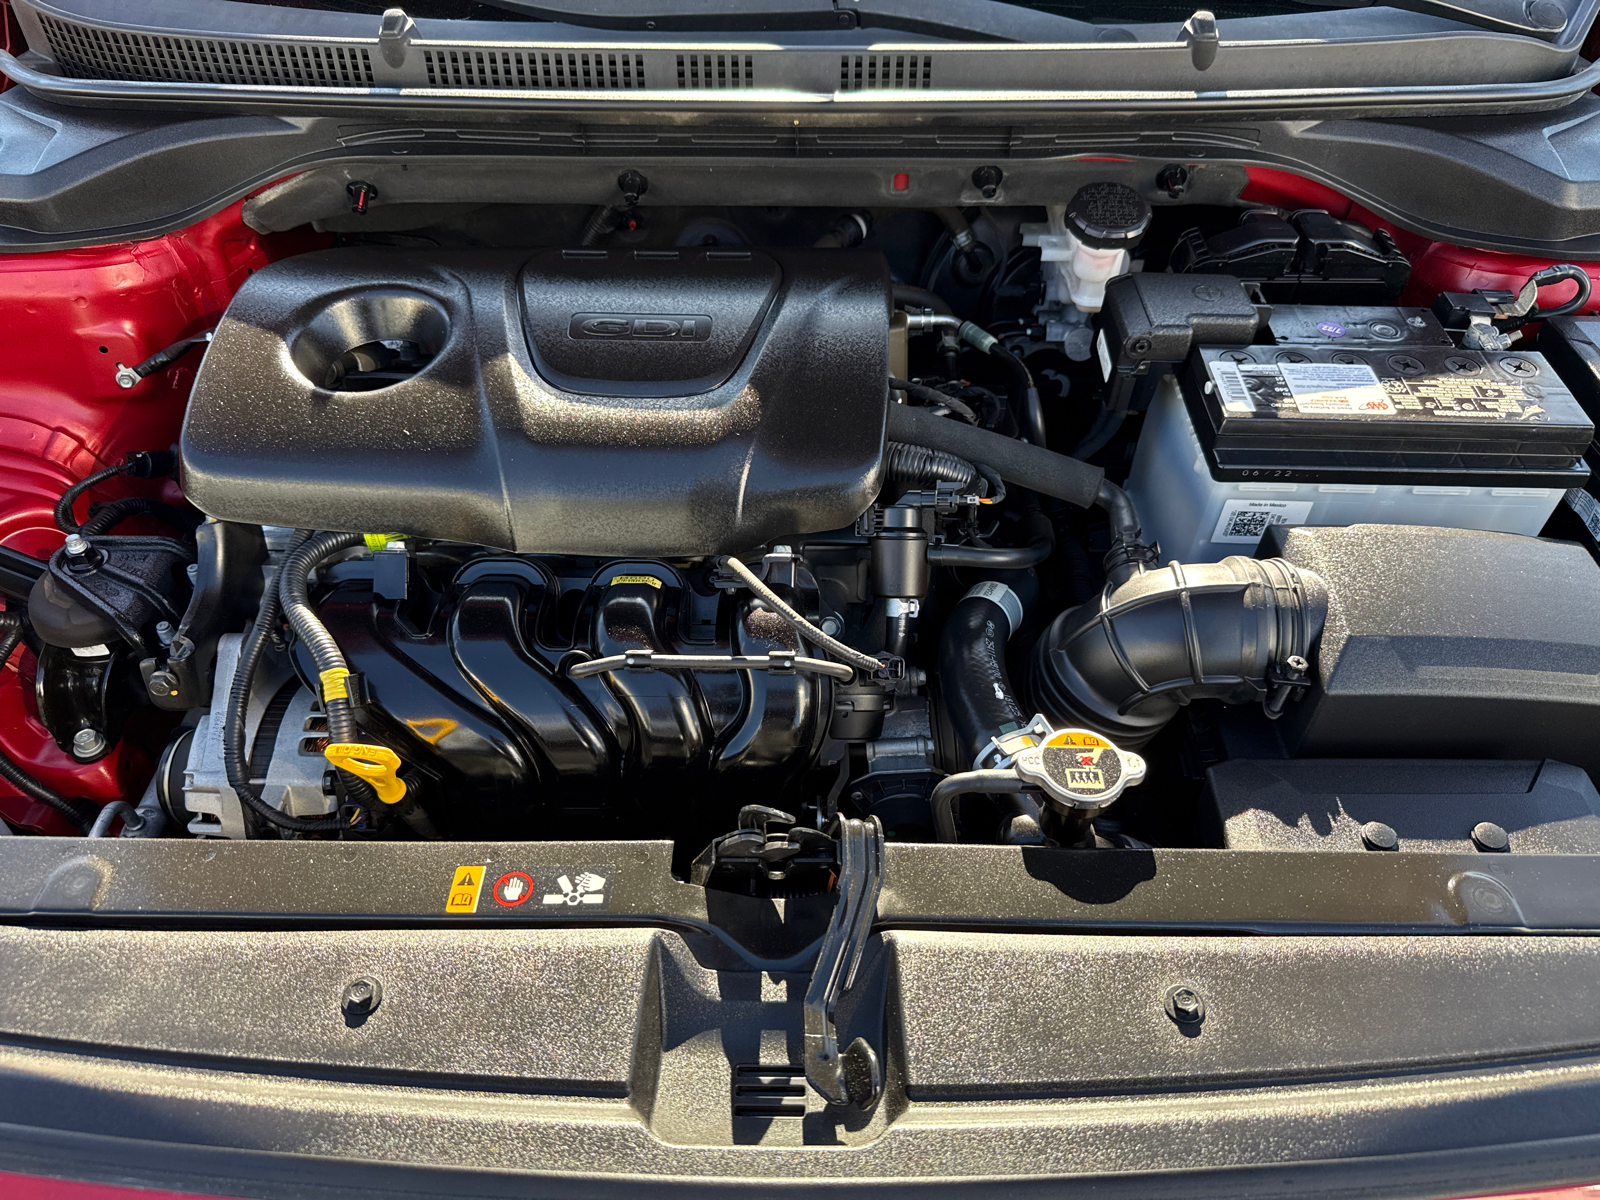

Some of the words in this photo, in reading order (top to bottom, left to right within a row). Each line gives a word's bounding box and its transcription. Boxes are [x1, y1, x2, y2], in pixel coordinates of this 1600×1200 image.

[581, 318, 696, 338] GDI
[1321, 324, 1342, 335] 7/22
[1365, 402, 1389, 411] AAA
[335, 745, 351, 755] OIL
[353, 746, 377, 757] ENG
[1021, 756, 1041, 765] HCC
